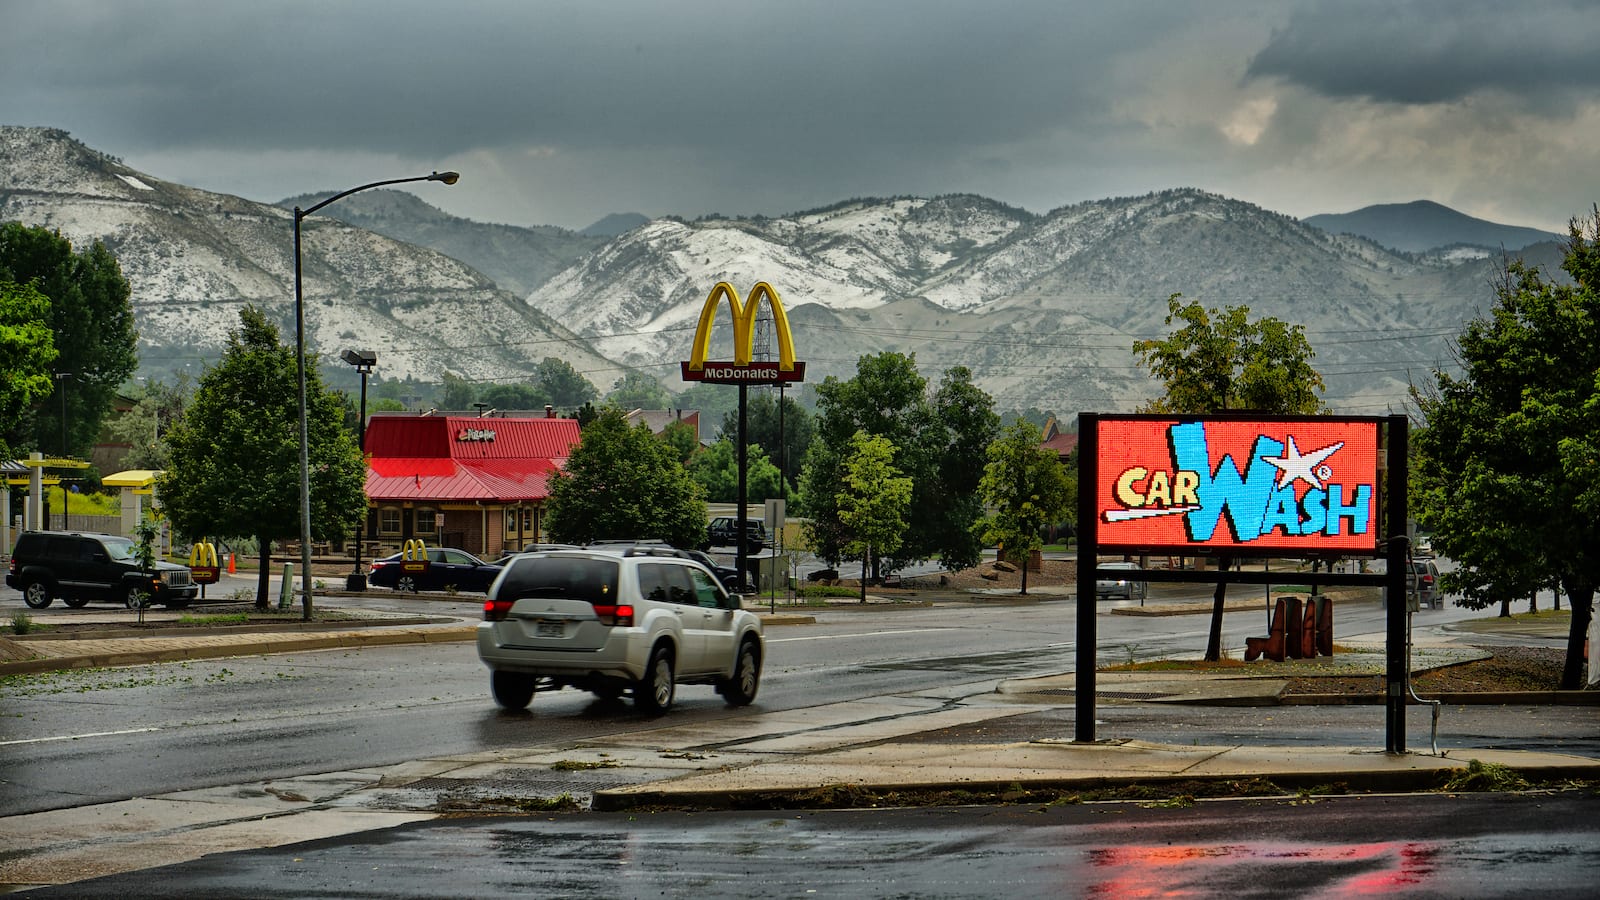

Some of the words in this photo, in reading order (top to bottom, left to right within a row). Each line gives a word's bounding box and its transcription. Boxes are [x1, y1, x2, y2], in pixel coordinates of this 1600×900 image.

[704, 368, 778, 379] McDonald's
[1112, 466, 1201, 507] CAR
[1166, 421, 1373, 543] WASH
